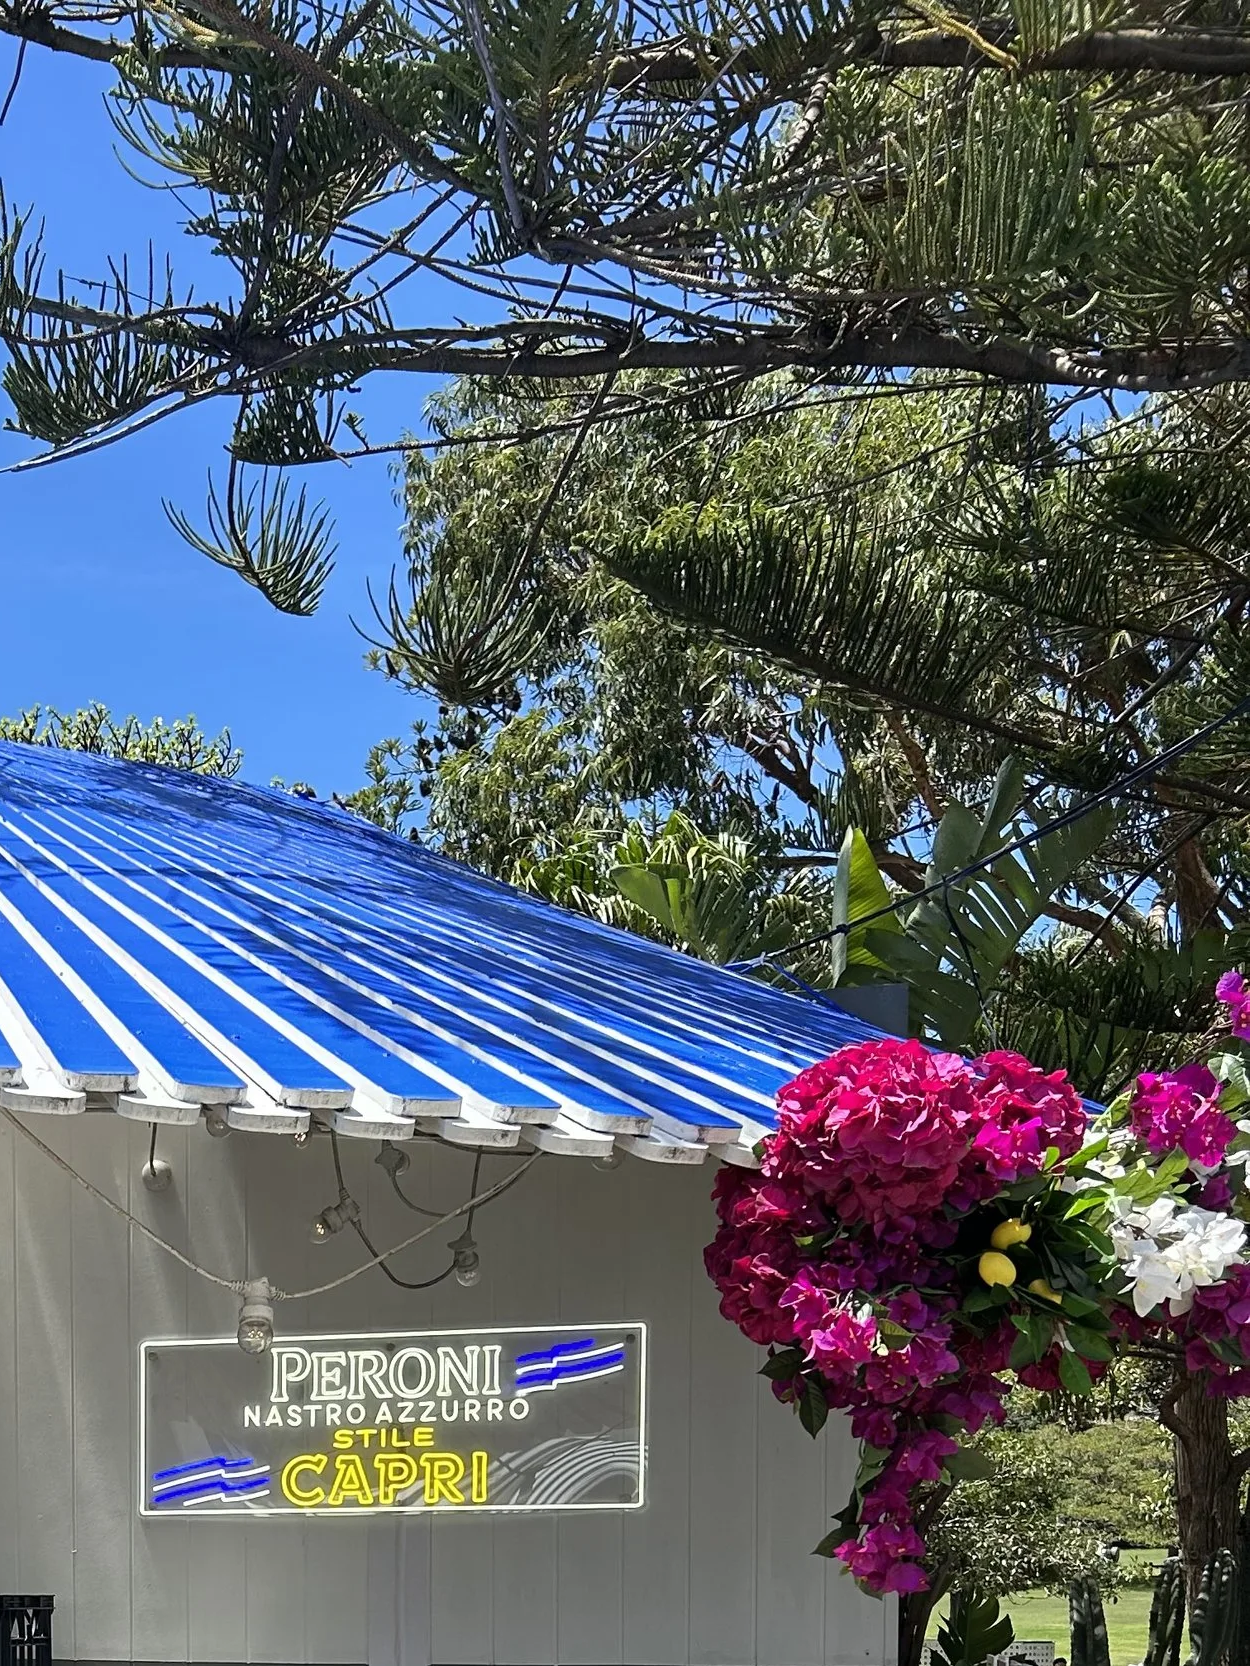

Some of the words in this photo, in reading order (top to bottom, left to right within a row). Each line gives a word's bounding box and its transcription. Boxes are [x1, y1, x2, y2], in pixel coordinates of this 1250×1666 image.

[271, 1345, 502, 1403] PERONI
[243, 1405, 366, 1428] NASTRO
[375, 1398, 530, 1424] AZZURRO
[333, 1427, 435, 1449] STILE
[281, 1451, 489, 1507] CAPRI
